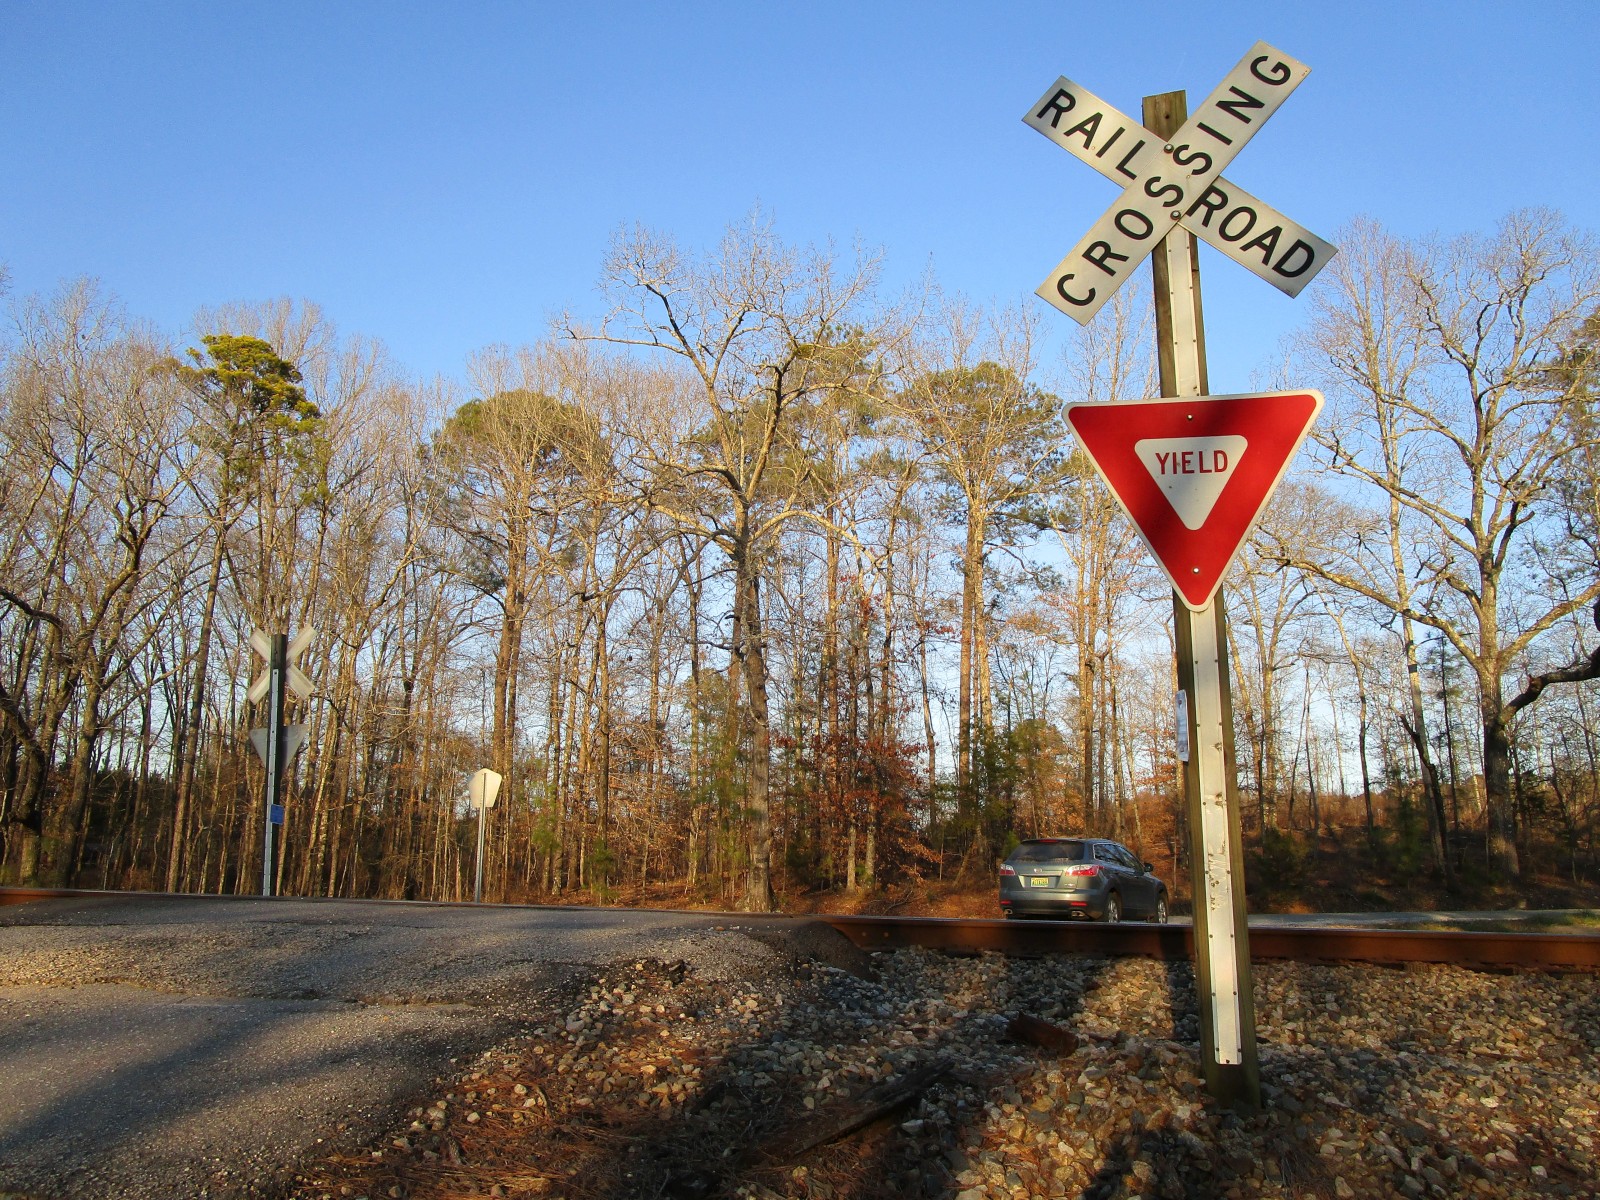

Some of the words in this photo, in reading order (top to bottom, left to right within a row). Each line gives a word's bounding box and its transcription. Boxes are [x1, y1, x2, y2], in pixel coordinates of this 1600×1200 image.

[1036, 88, 1146, 181] RAIL
[1186, 184, 1315, 278] ROAD
[1057, 55, 1291, 307] CROSSING
[1155, 449, 1229, 475] YIELD
